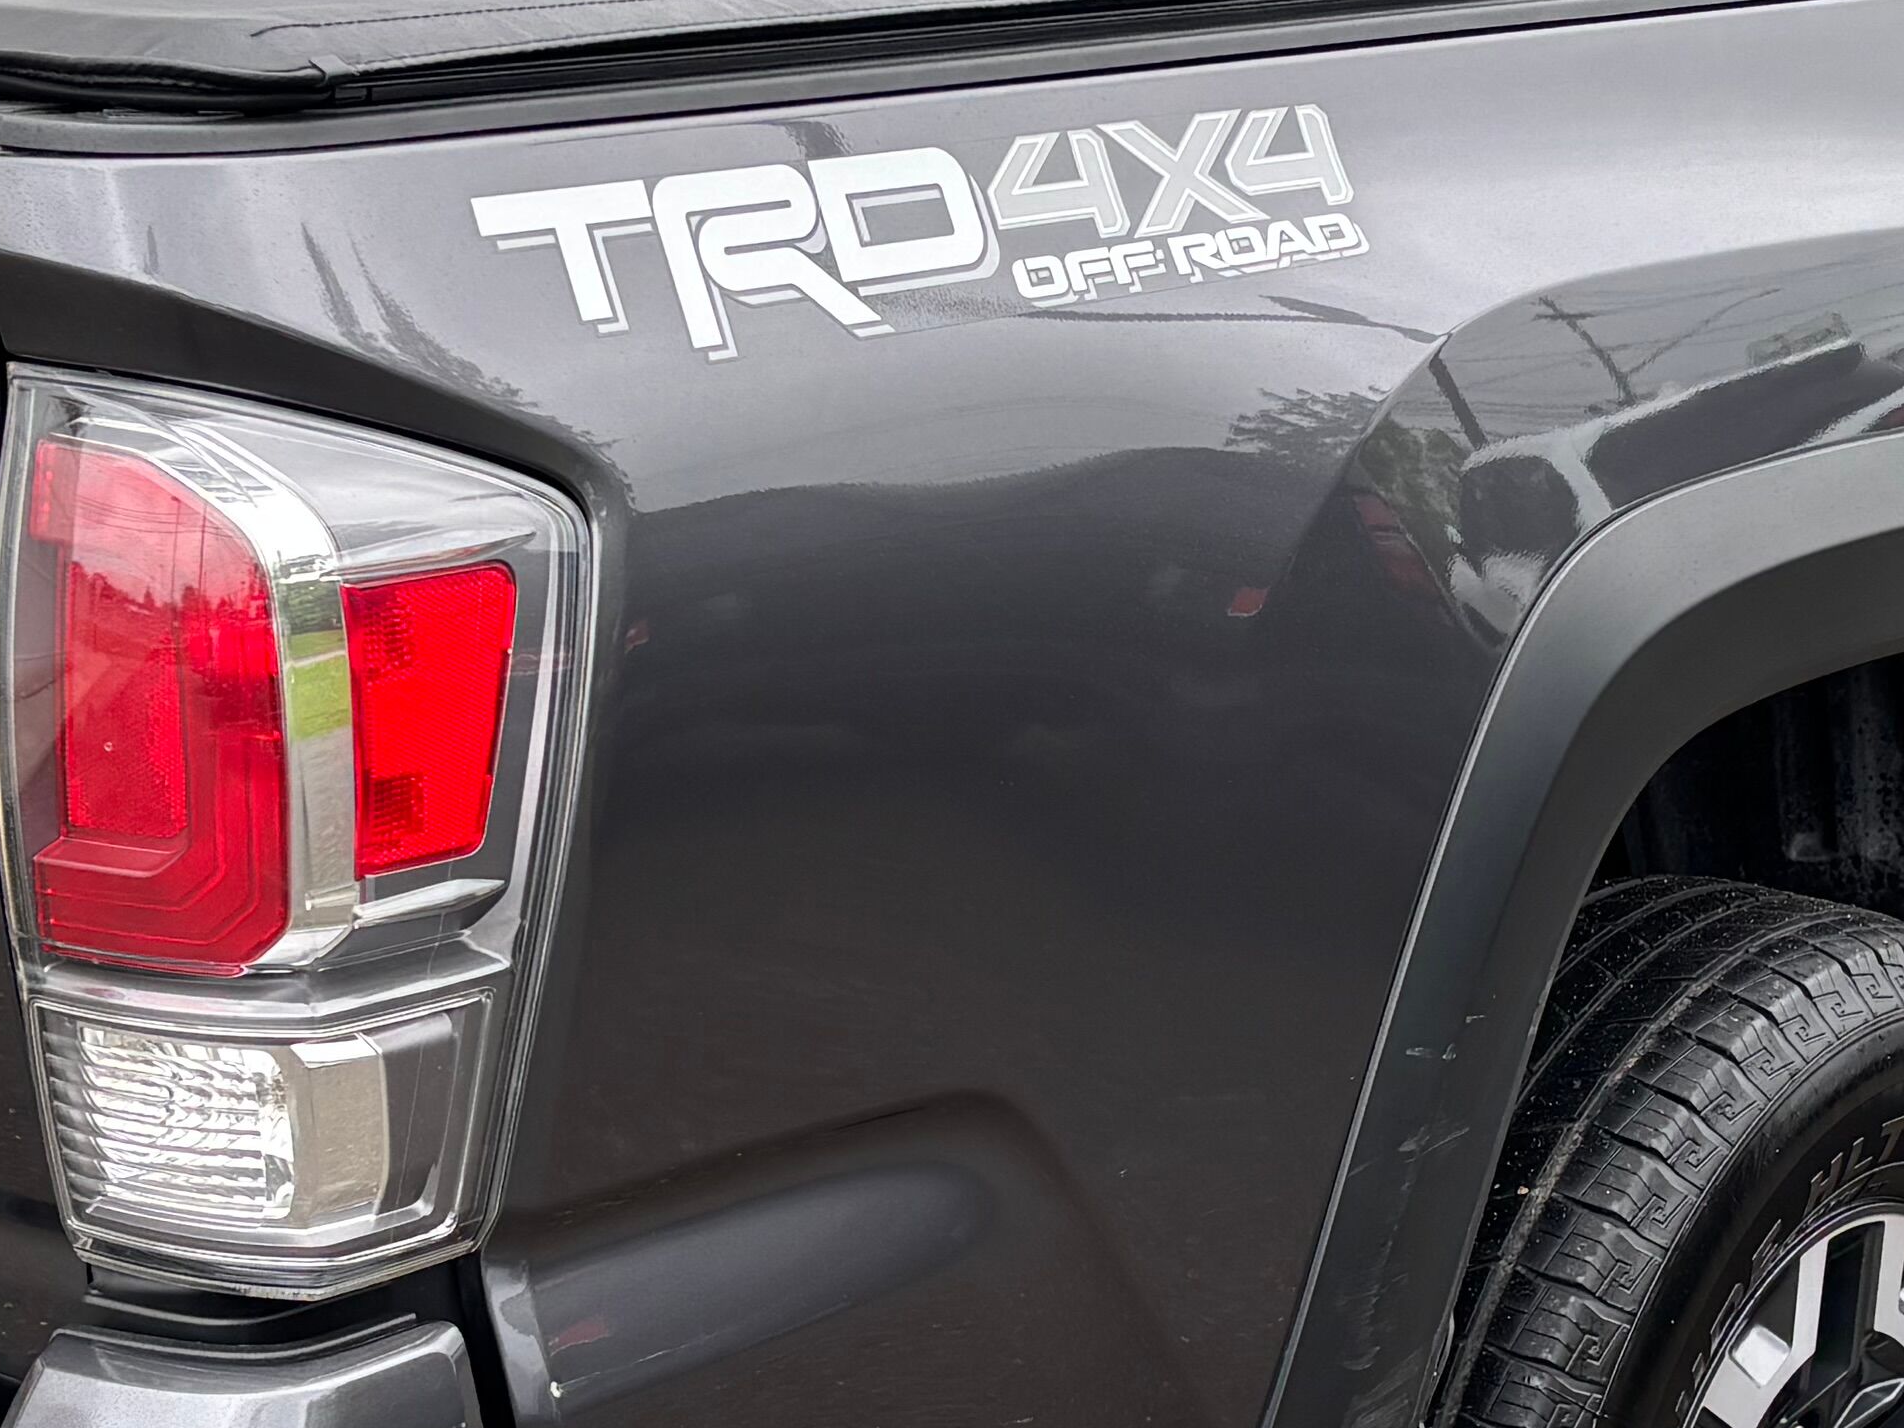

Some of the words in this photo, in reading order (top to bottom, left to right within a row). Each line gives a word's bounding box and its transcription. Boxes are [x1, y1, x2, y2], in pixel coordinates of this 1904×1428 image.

[471, 146, 1001, 363] TRD
[985, 103, 1356, 239] 4X4
[1011, 236, 1164, 308] OFF
[1166, 210, 1369, 284] ROAD
